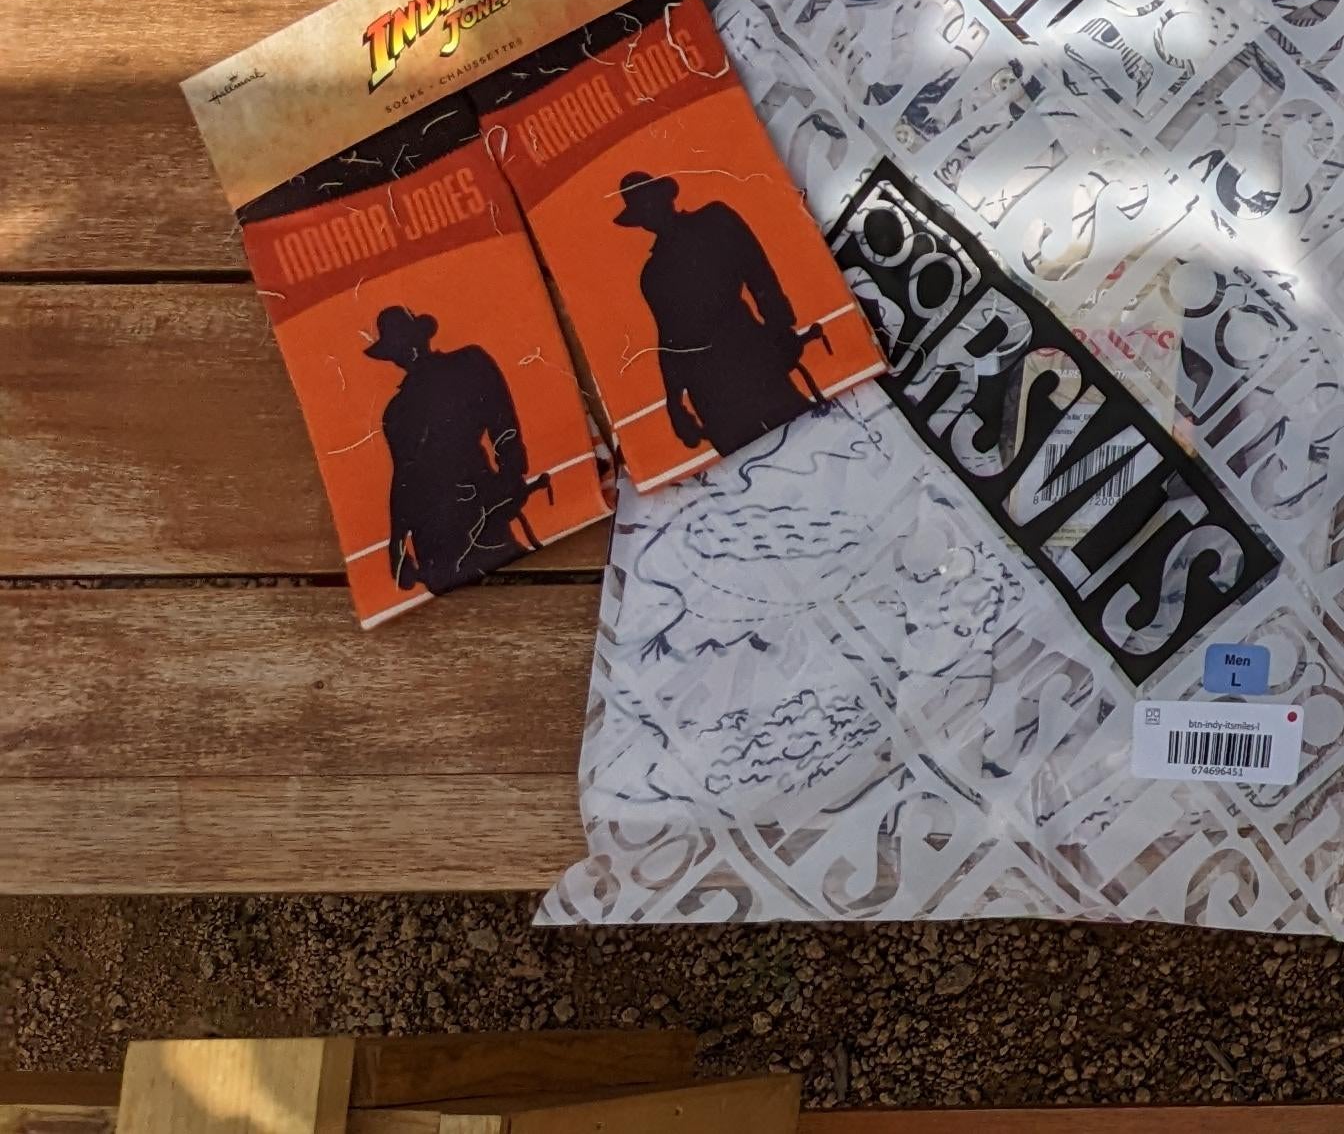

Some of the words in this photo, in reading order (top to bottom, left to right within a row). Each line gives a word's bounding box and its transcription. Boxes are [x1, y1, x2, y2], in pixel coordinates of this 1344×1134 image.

[516, 73, 622, 167] INDIANA
[625, 29, 707, 107] JONES
[273, 203, 397, 284] INDIANA
[402, 166, 488, 242] JONES
[904, 286, 1247, 656] RSVLTS
[1224, 654, 1251, 667] Men
[1230, 672, 1241, 687] L
[1190, 766, 1244, 777] 674696451
